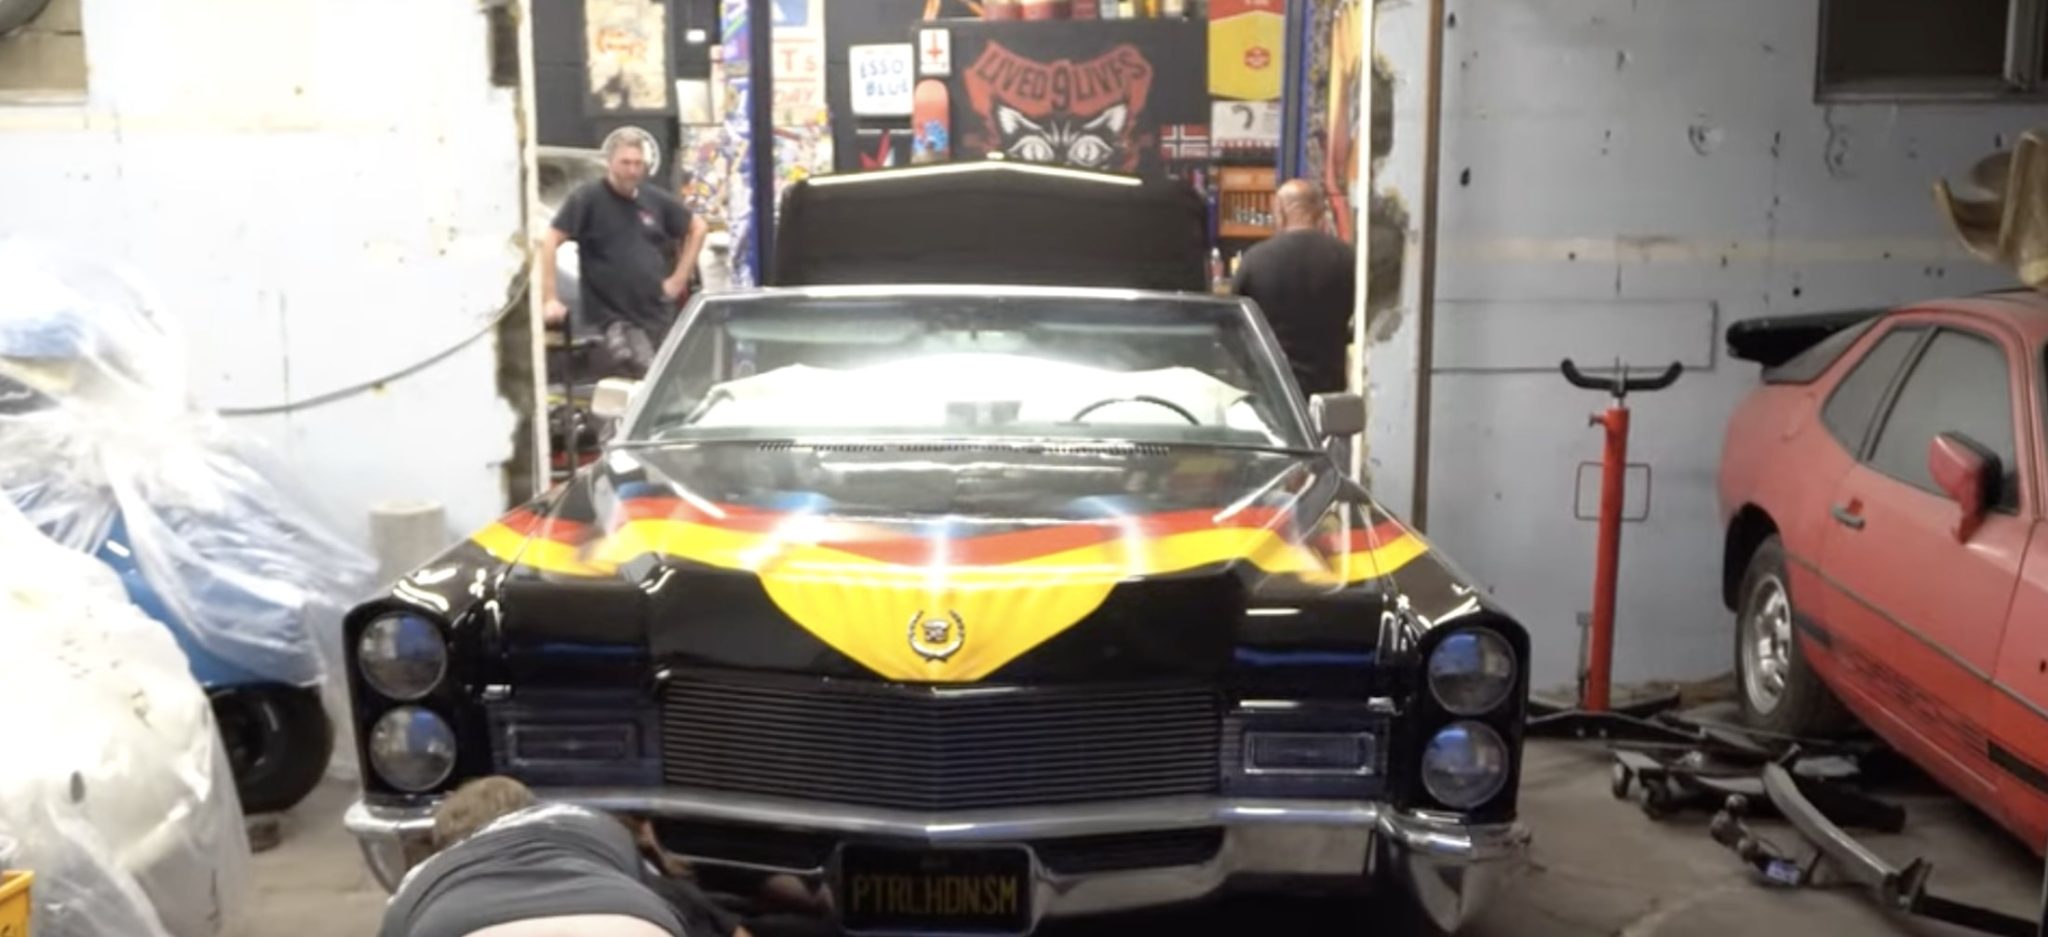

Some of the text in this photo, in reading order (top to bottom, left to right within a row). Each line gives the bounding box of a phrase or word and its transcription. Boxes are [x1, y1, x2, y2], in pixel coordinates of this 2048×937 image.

[859, 57, 904, 79] ESSO
[865, 78, 909, 97] BLUE
[976, 50, 1147, 110] LIVED 9 LIVES
